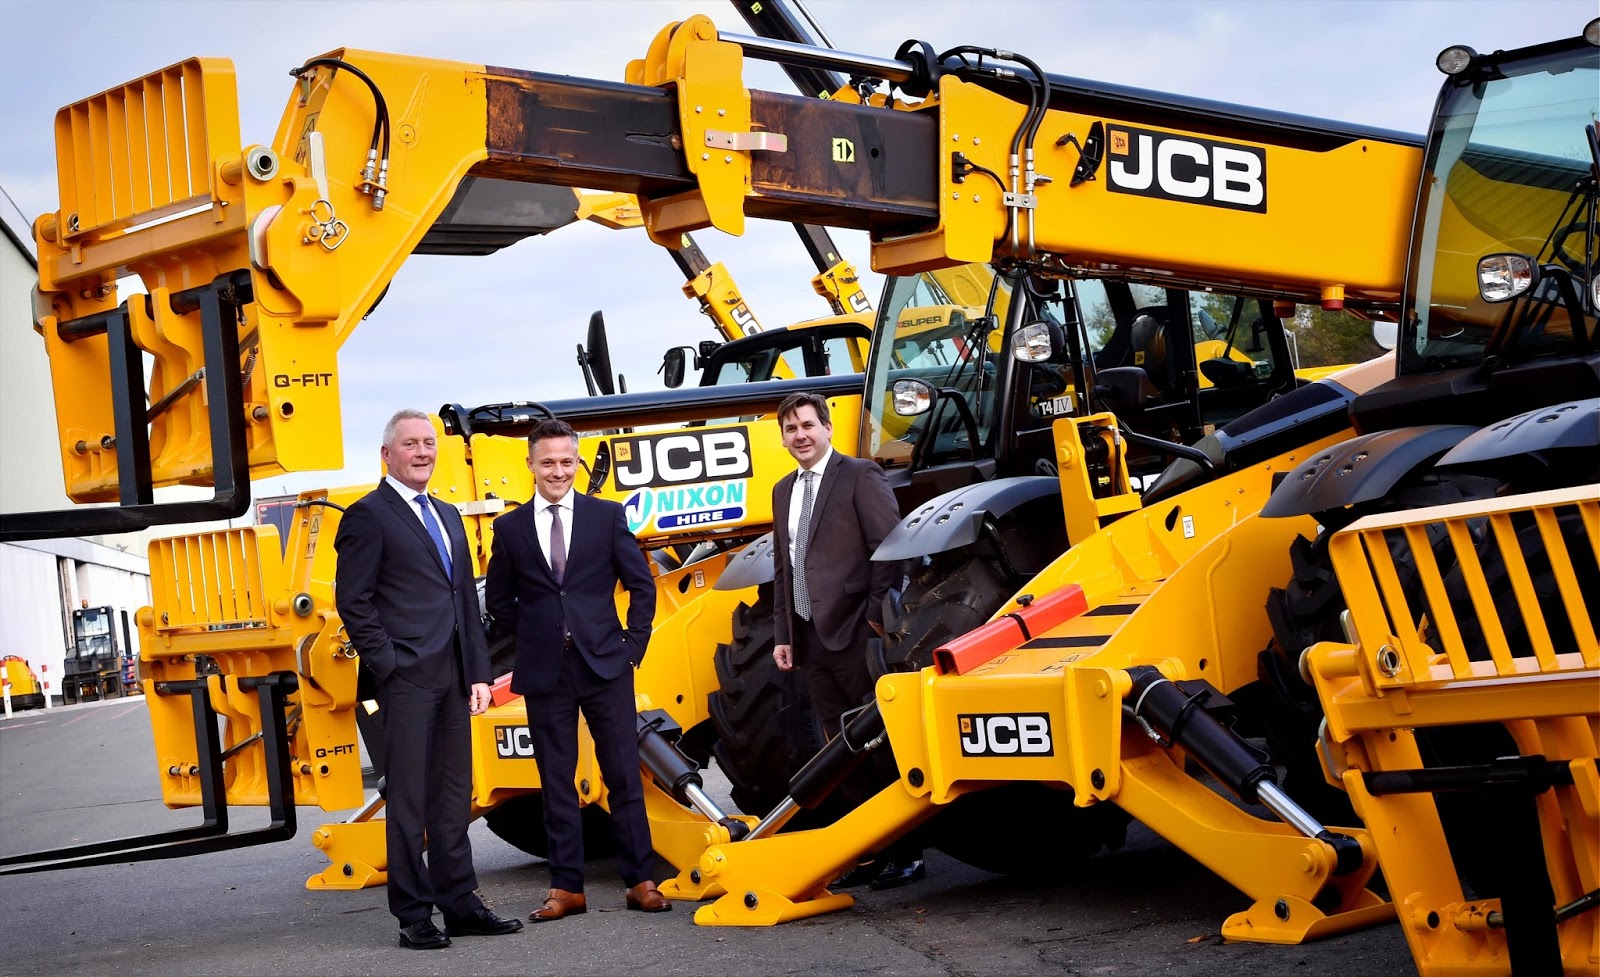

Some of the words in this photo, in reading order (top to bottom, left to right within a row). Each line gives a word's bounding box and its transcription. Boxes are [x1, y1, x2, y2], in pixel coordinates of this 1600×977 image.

[1110, 134, 1264, 206] JCB
[731, 307, 764, 337] JC
[274, 373, 333, 388] Q-FIT
[1039, 401, 1053, 415] T4
[616, 431, 750, 486] JCB
[657, 482, 744, 513] NIXON
[676, 510, 724, 526] HIRE
[497, 727, 535, 757] JC
[962, 716, 1051, 754] JCB
[315, 743, 355, 758] Q-FIT
